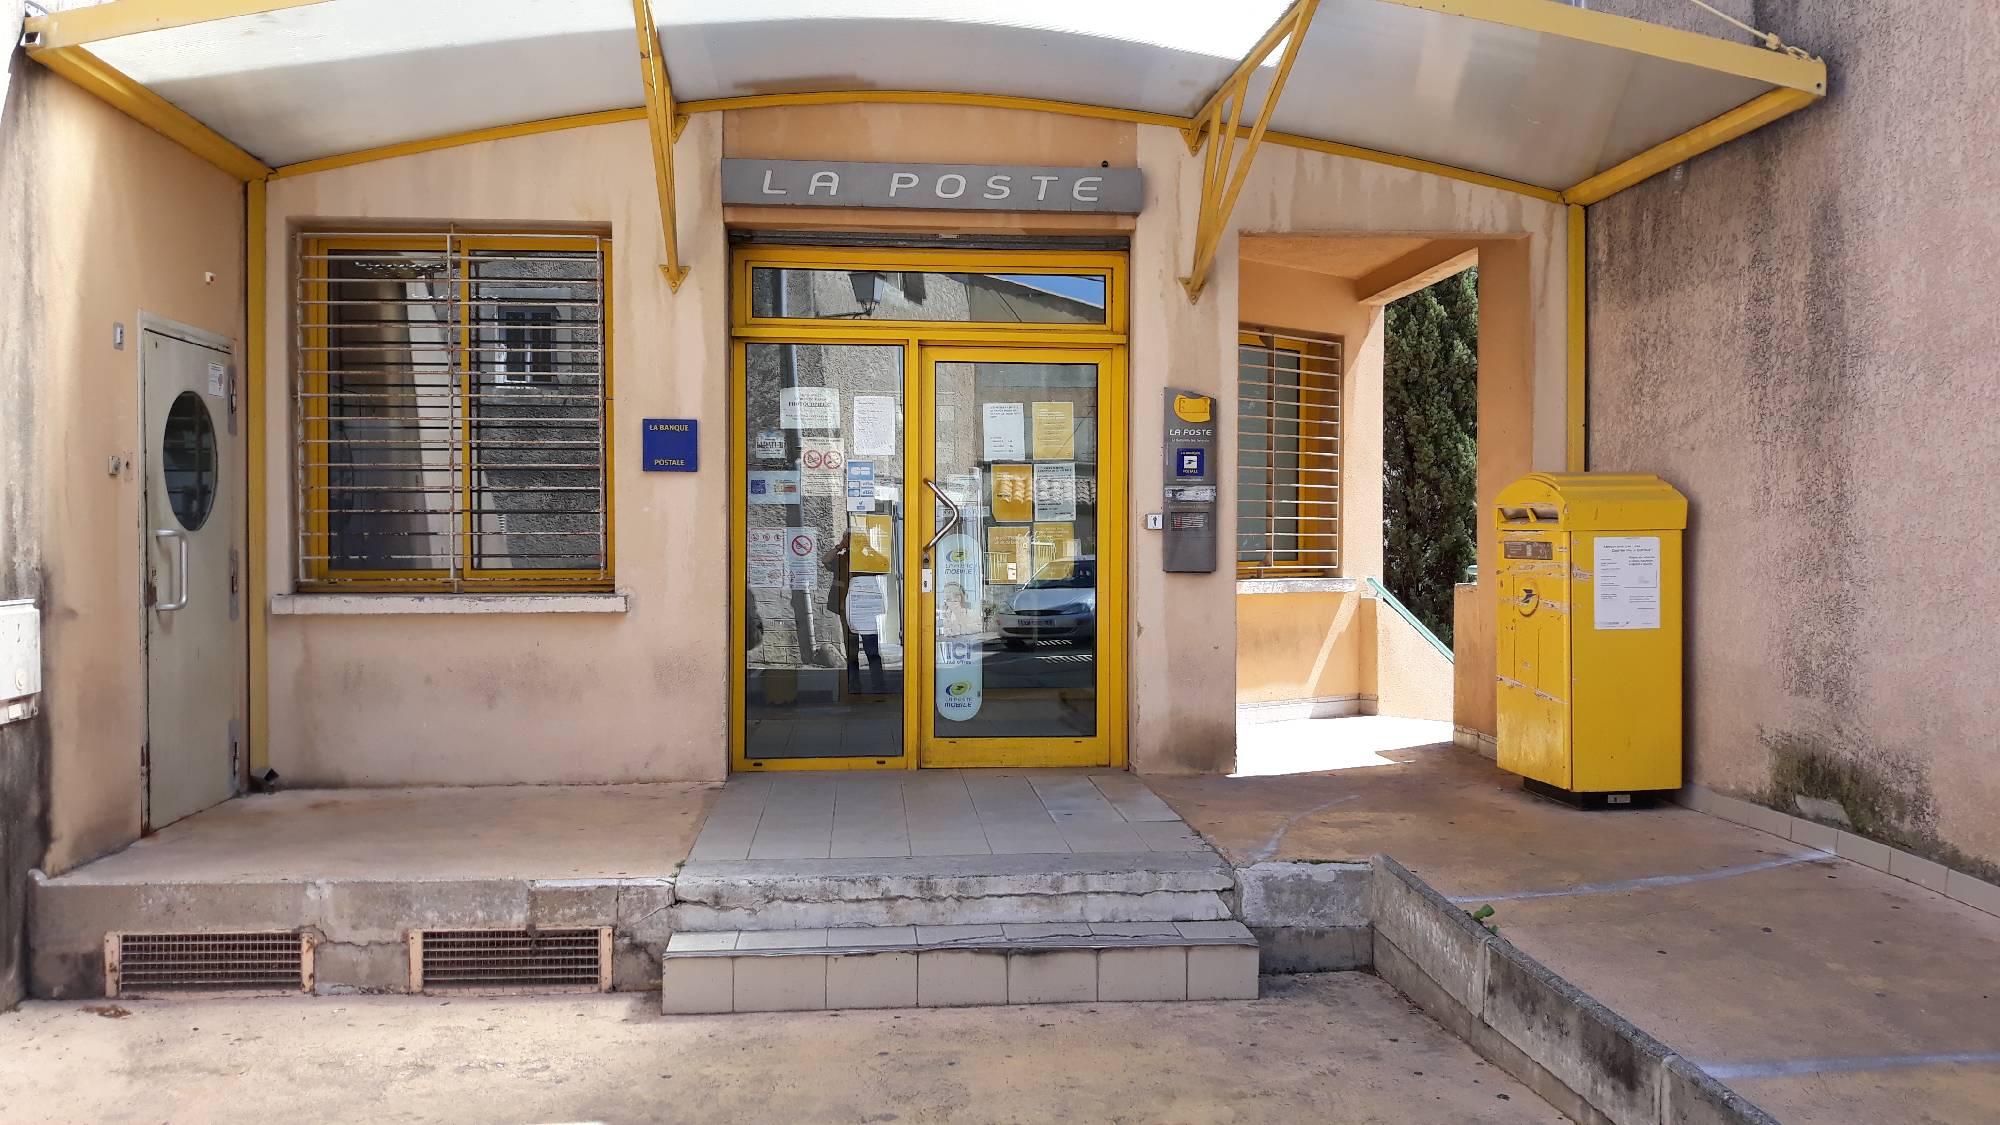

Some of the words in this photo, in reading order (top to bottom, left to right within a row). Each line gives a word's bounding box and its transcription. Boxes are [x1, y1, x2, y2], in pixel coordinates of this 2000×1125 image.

[761, 169, 841, 197] LA
[887, 172, 1103, 202] POSTE
[659, 424, 689, 432] BANQUE
